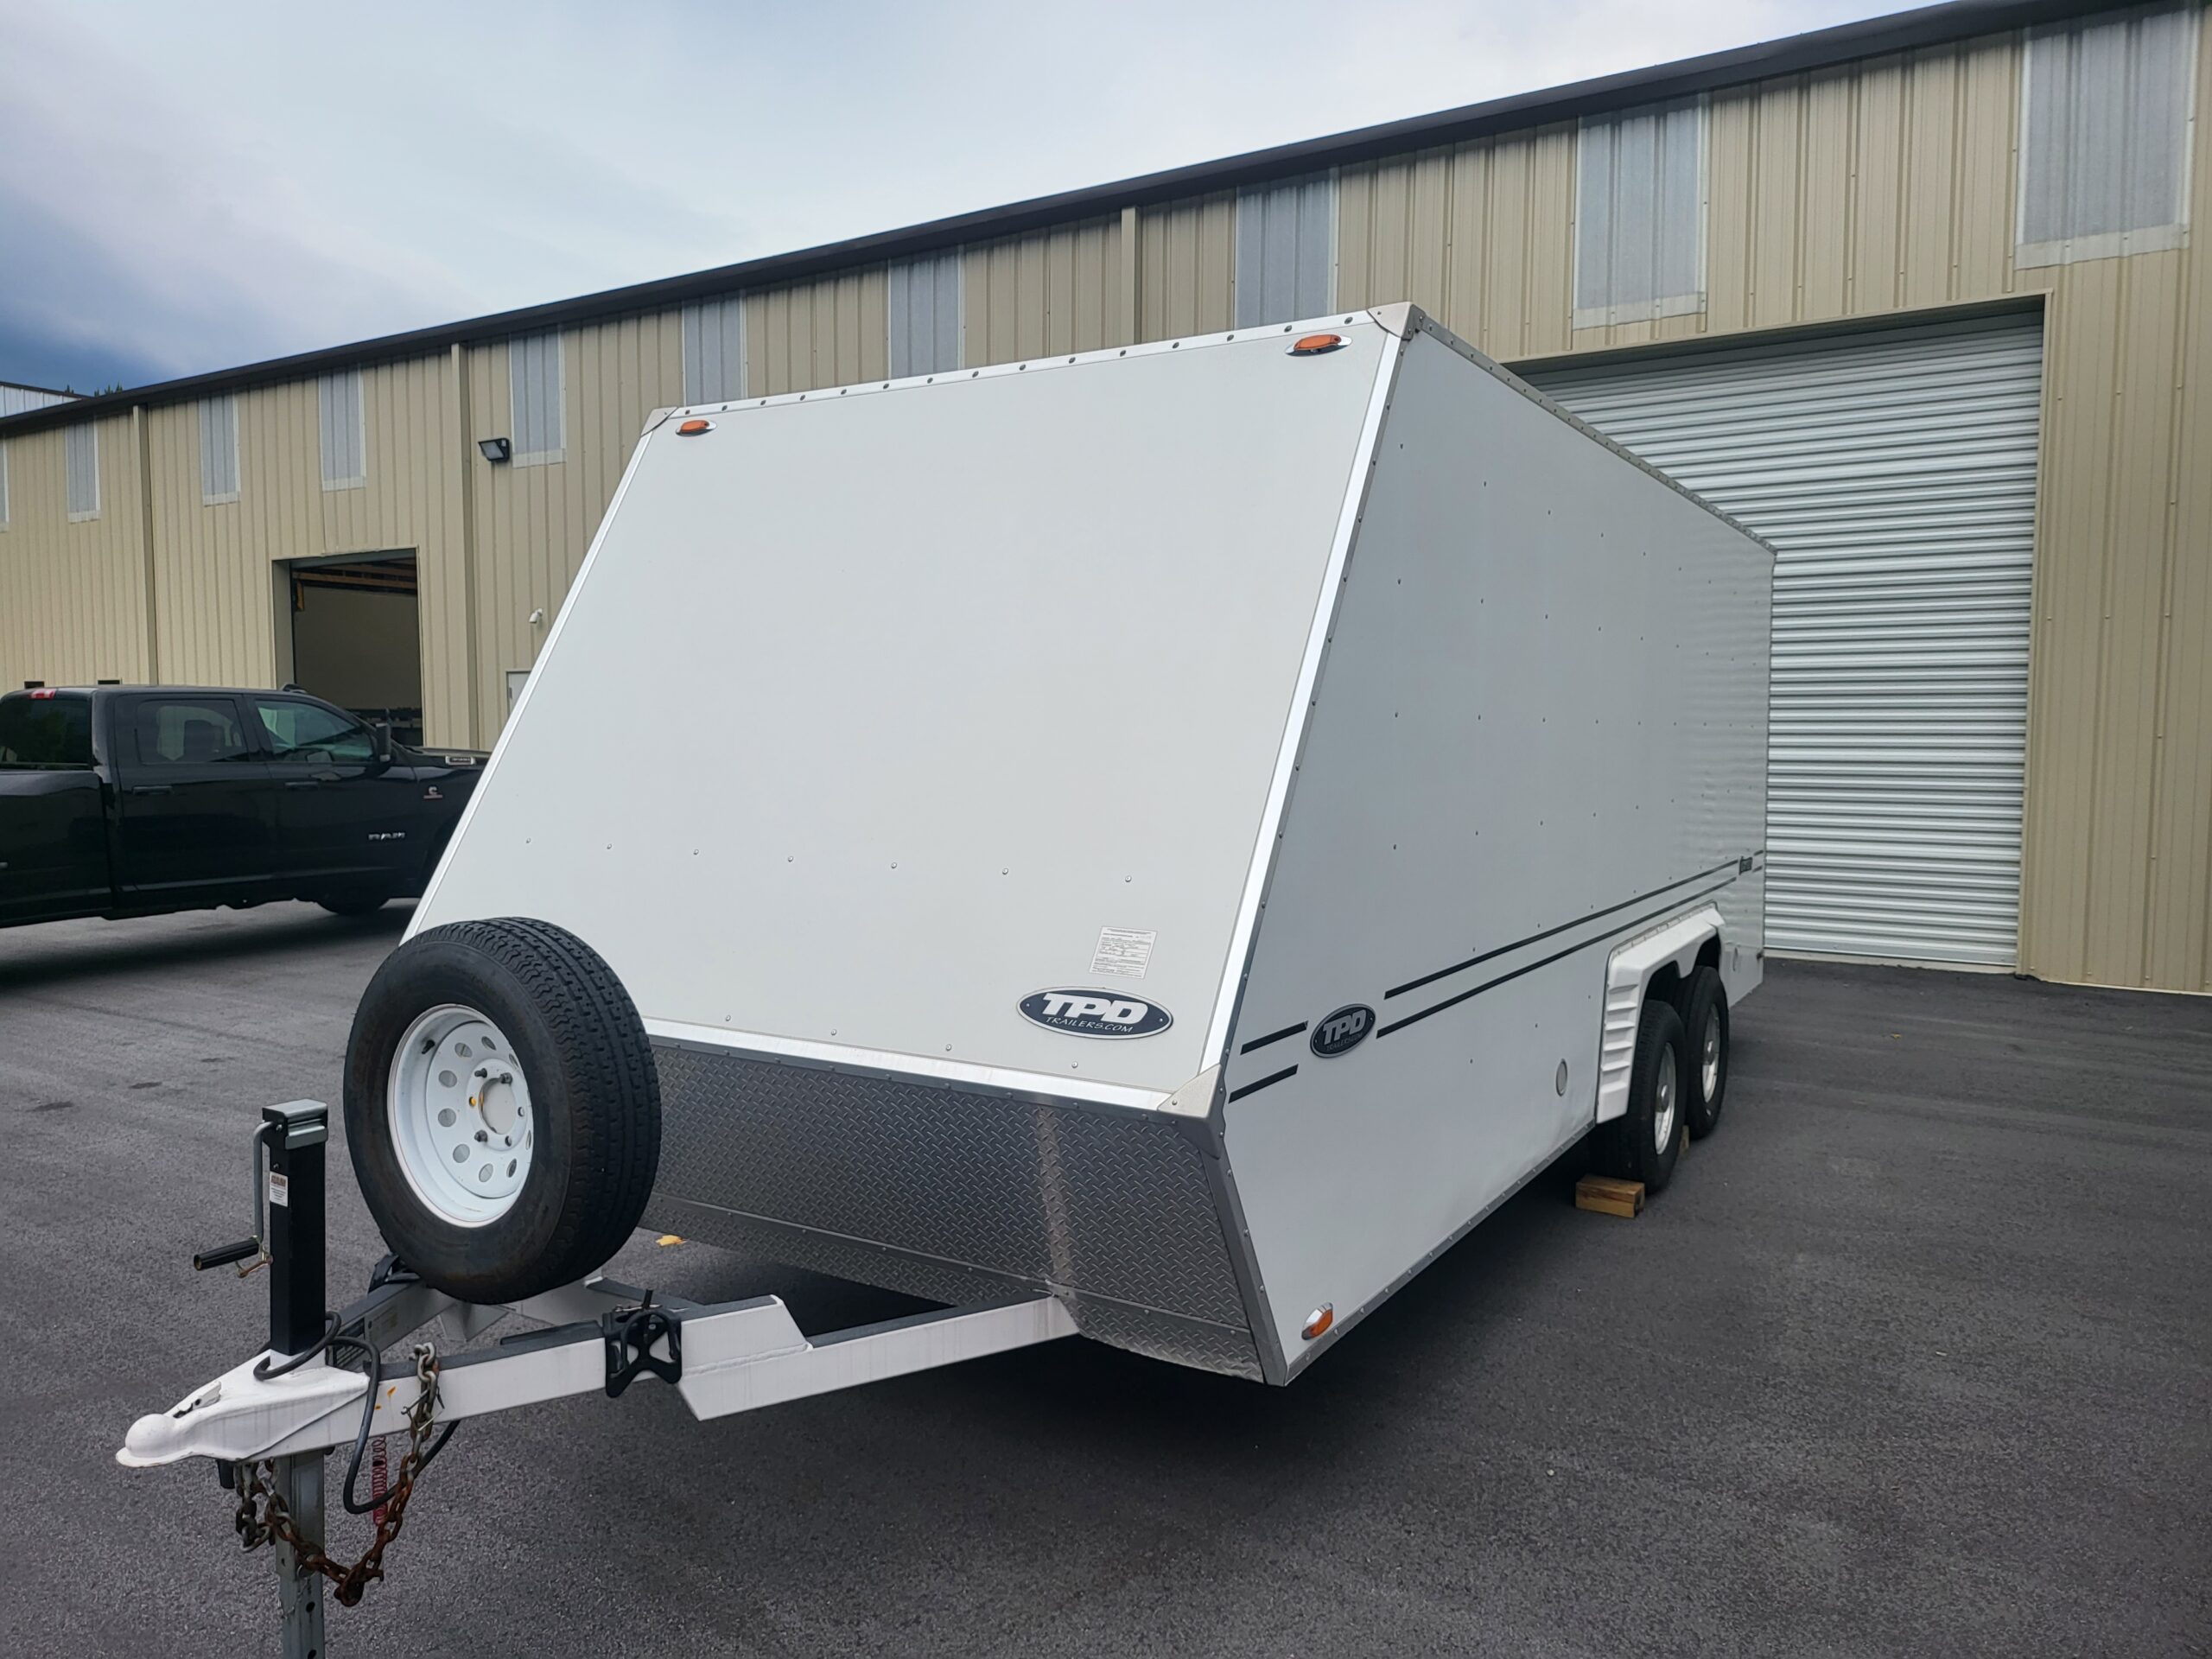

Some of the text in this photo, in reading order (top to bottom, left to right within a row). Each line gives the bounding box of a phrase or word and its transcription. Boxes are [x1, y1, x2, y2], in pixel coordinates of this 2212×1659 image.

[1042, 993, 1148, 1025] TPD
[1046, 1016, 1134, 1033] TRAILERS.COM
[1323, 1009, 1367, 1046] TPD
